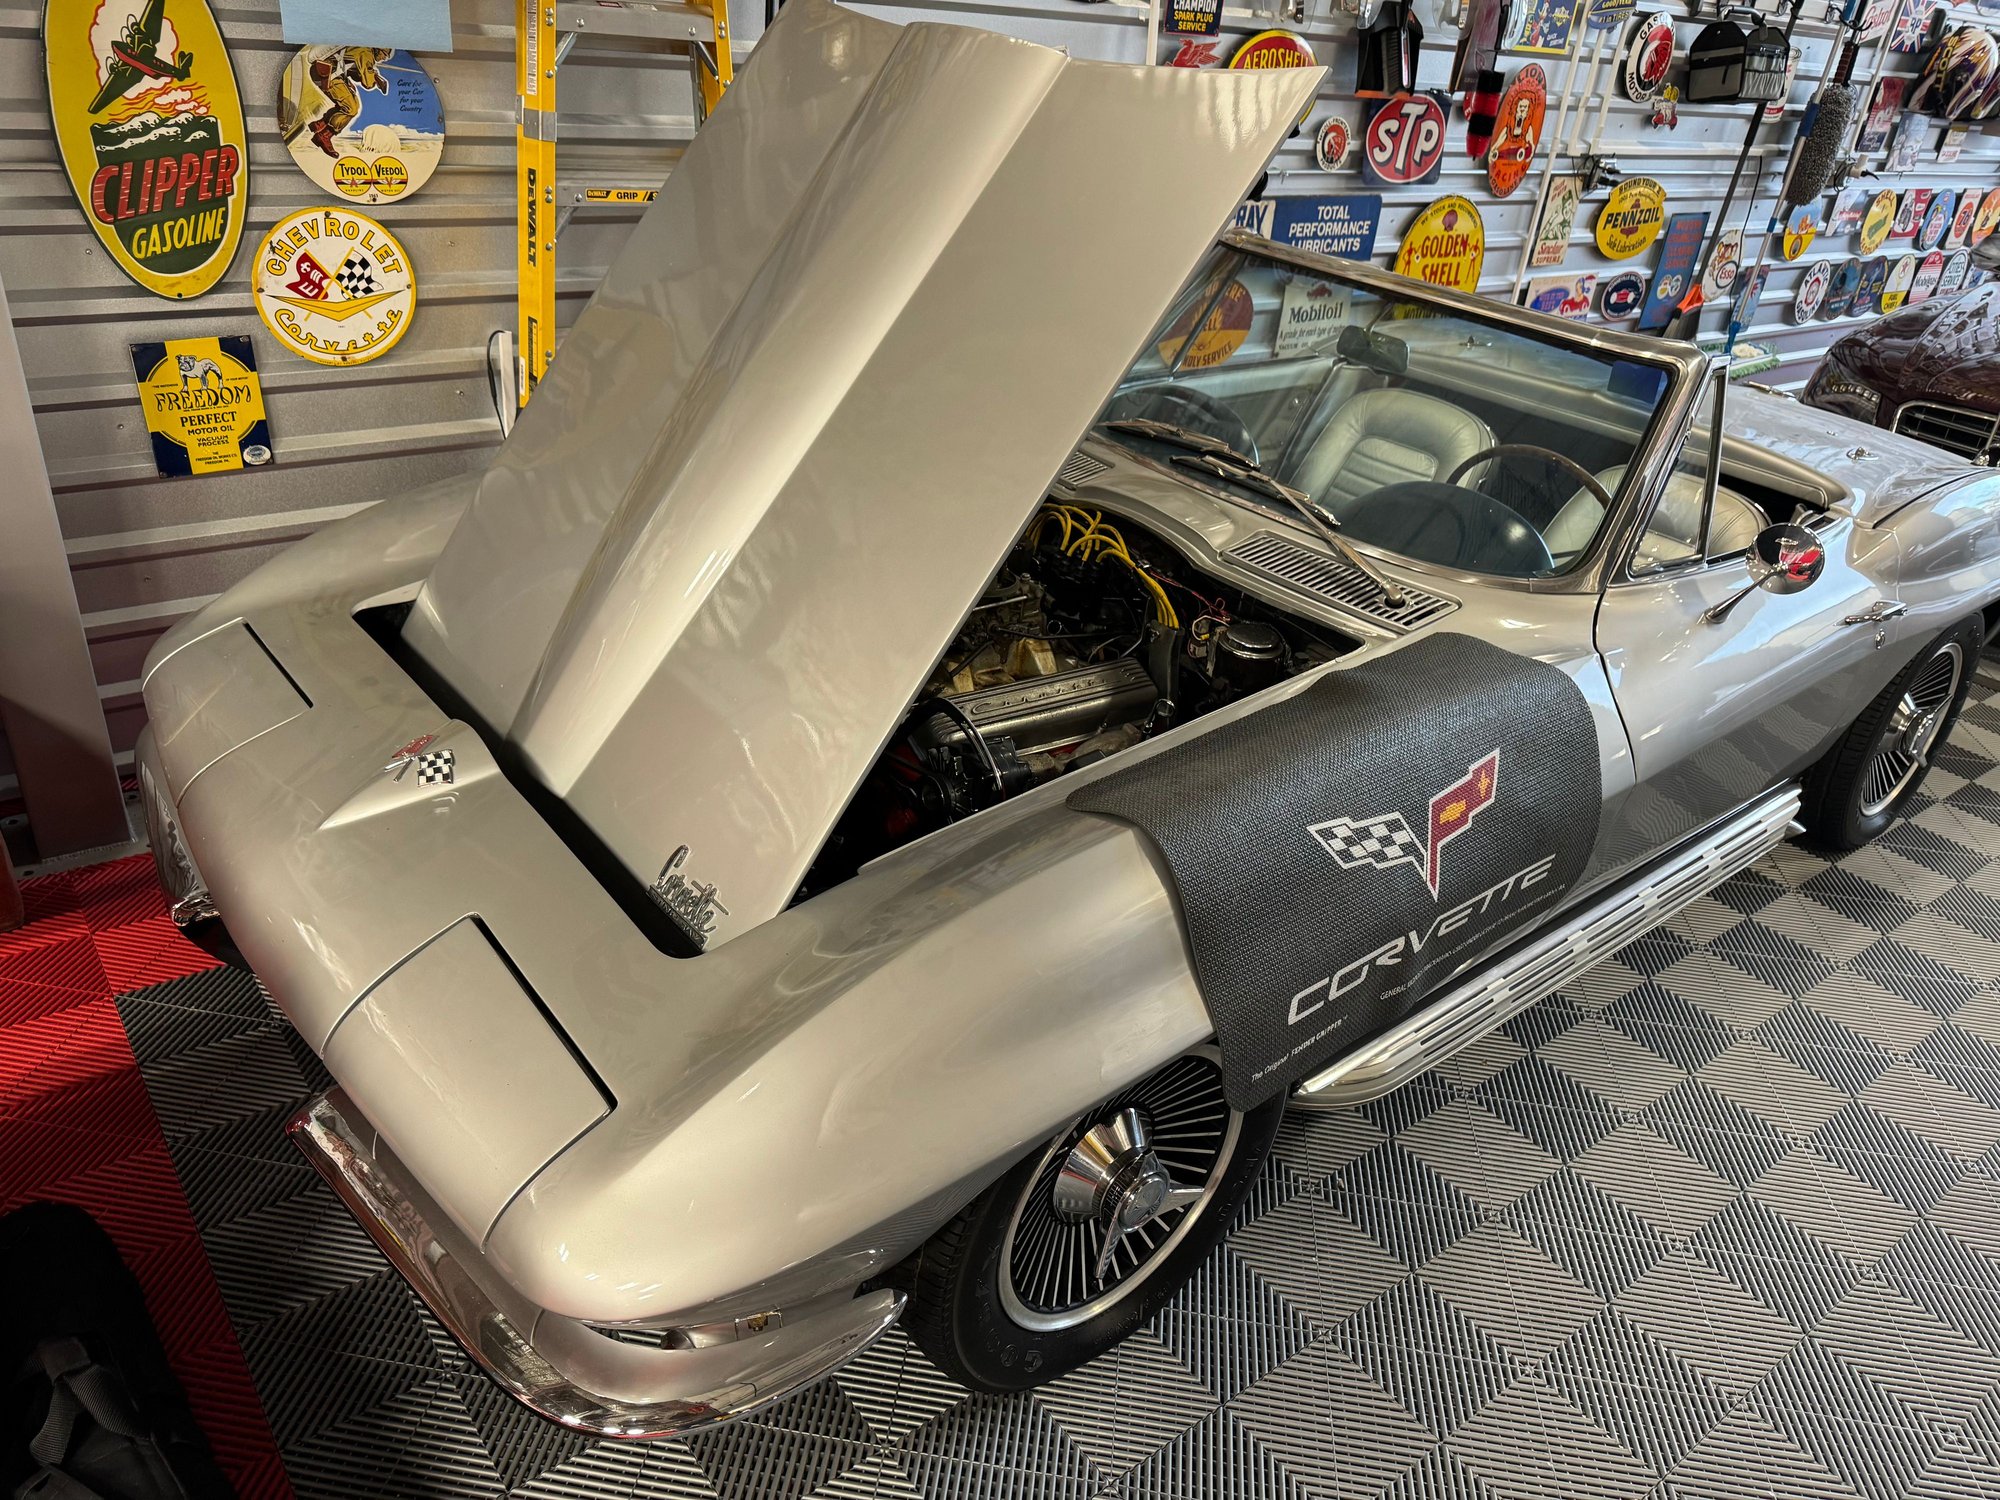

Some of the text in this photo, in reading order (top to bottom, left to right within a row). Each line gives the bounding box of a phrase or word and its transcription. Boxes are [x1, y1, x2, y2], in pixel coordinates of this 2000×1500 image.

[1174, 0, 1217, 13] CHAMPION
[1174, 10, 1213, 22] SPARK PLUG
[1178, 21, 1206, 31] SERVICE
[397, 79, 411, 87] Care
[1628, 72, 1647, 101] MOTOR
[1373, 103, 1441, 174] STP
[339, 164, 367, 177] TYDOL
[375, 164, 404, 177] VEEDOL
[91, 147, 240, 223] CLIPPER
[616, 192, 638, 200] GRIP
[1317, 205, 1350, 220] TOTAL
[1603, 207, 1660, 230] PENNZOIL
[133, 207, 225, 260] GASOLINE
[1289, 221, 1371, 237] PERFORMANCE
[266, 218, 402, 276] CHEVROLET
[1292, 238, 1361, 253] LUBRICANTS
[1422, 234, 1469, 258] GOLDEN
[1421, 262, 1461, 286] SHELL
[1804, 261, 1829, 289] ATLANTIC
[1289, 302, 1343, 324] Mobiloil
[275, 308, 403, 355] Corvette
[1202, 341, 1233, 367] SERVICE
[154, 385, 252, 412] FREEDOM
[180, 411, 237, 427] PERFECT
[187, 427, 219, 436] MOTOR
[1287, 853, 1556, 1026] CORVETTE
[1380, 982, 1407, 1000] GENERAL
[1251, 1071, 1263, 1082] The
[1264, 1053, 1289, 1074] Original
